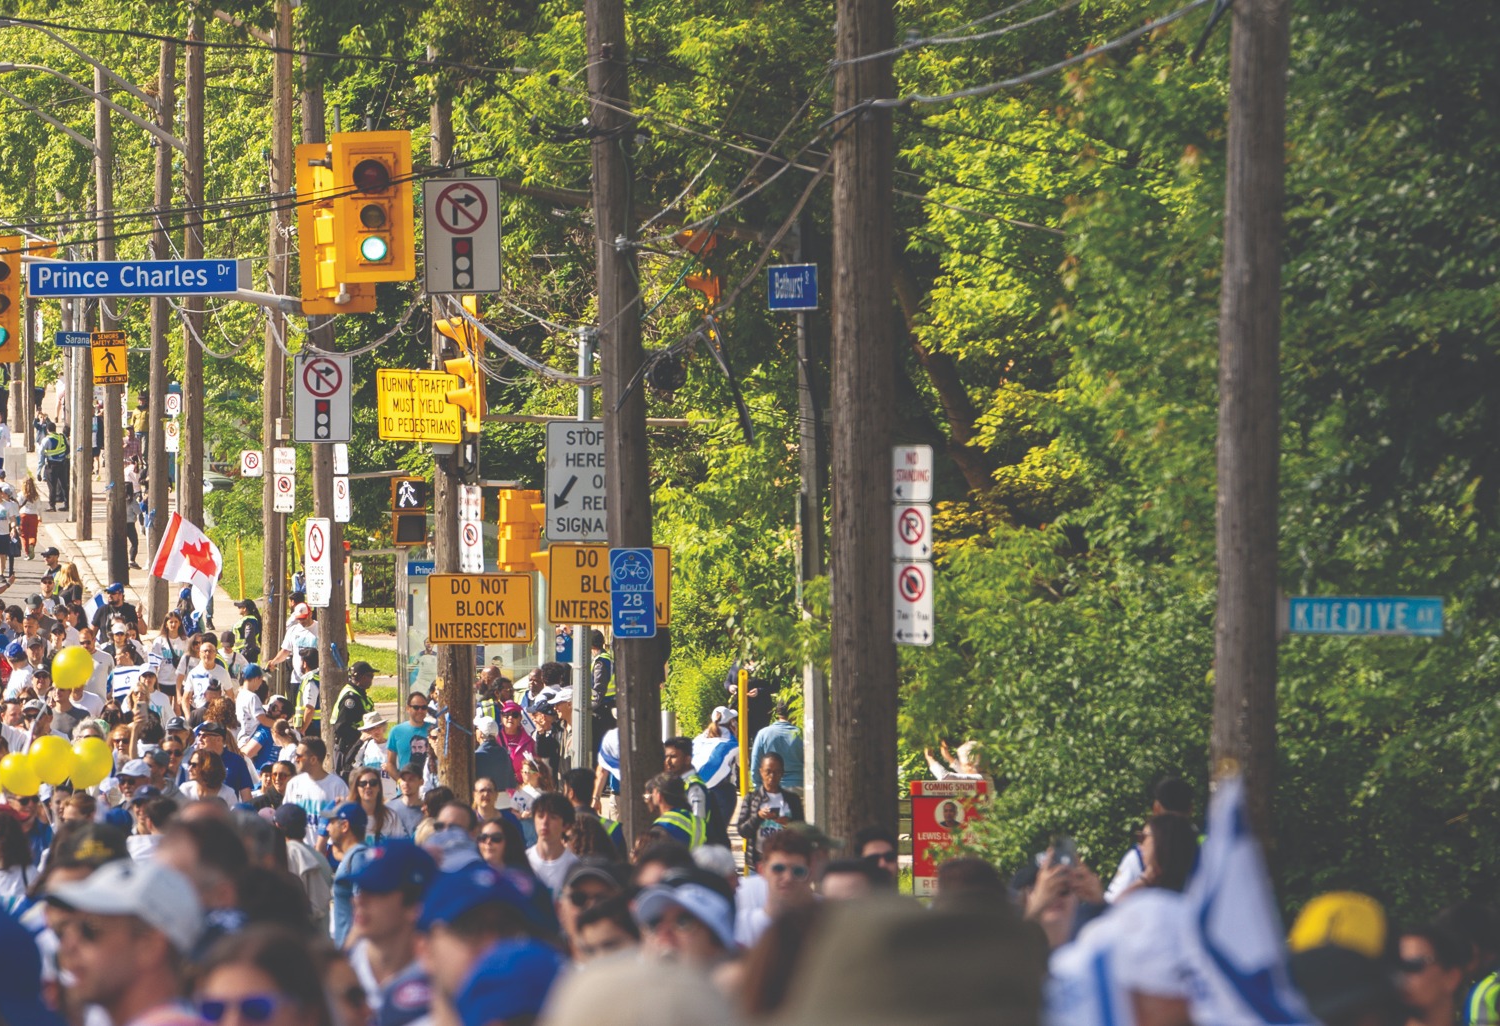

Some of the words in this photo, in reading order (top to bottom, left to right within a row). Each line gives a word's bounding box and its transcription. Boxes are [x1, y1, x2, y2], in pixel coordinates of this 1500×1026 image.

[38, 266, 109, 289] Prince
[119, 265, 208, 287] Charles
[217, 264, 230, 276] Dr
[65, 334, 91, 344] Sarana
[381, 376, 417, 393] TURNING
[419, 378, 455, 394] TRAFFIC
[392, 397, 415, 413] MUST
[419, 398, 445, 414] YIELD
[383, 416, 394, 432] TO
[398, 417, 457, 435] PEDESTRIANS
[565, 453, 606, 468] HERE
[905, 451, 919, 465] NO
[895, 468, 930, 482] STANDING
[582, 496, 607, 511] RE
[556, 517, 608, 533] SIGNA
[576, 550, 598, 568] DO
[451, 578, 471, 595] DO
[481, 578, 509, 595] NOT
[456, 600, 505, 617] BLOCK
[623, 593, 643, 607] 28
[555, 600, 663, 621] INTERSN
[1294, 602, 1410, 632] KHEDIVE
[435, 622, 527, 639] INTERSECTION
[924, 783, 954, 791] COMING
[917, 832, 941, 841] LEWIS
